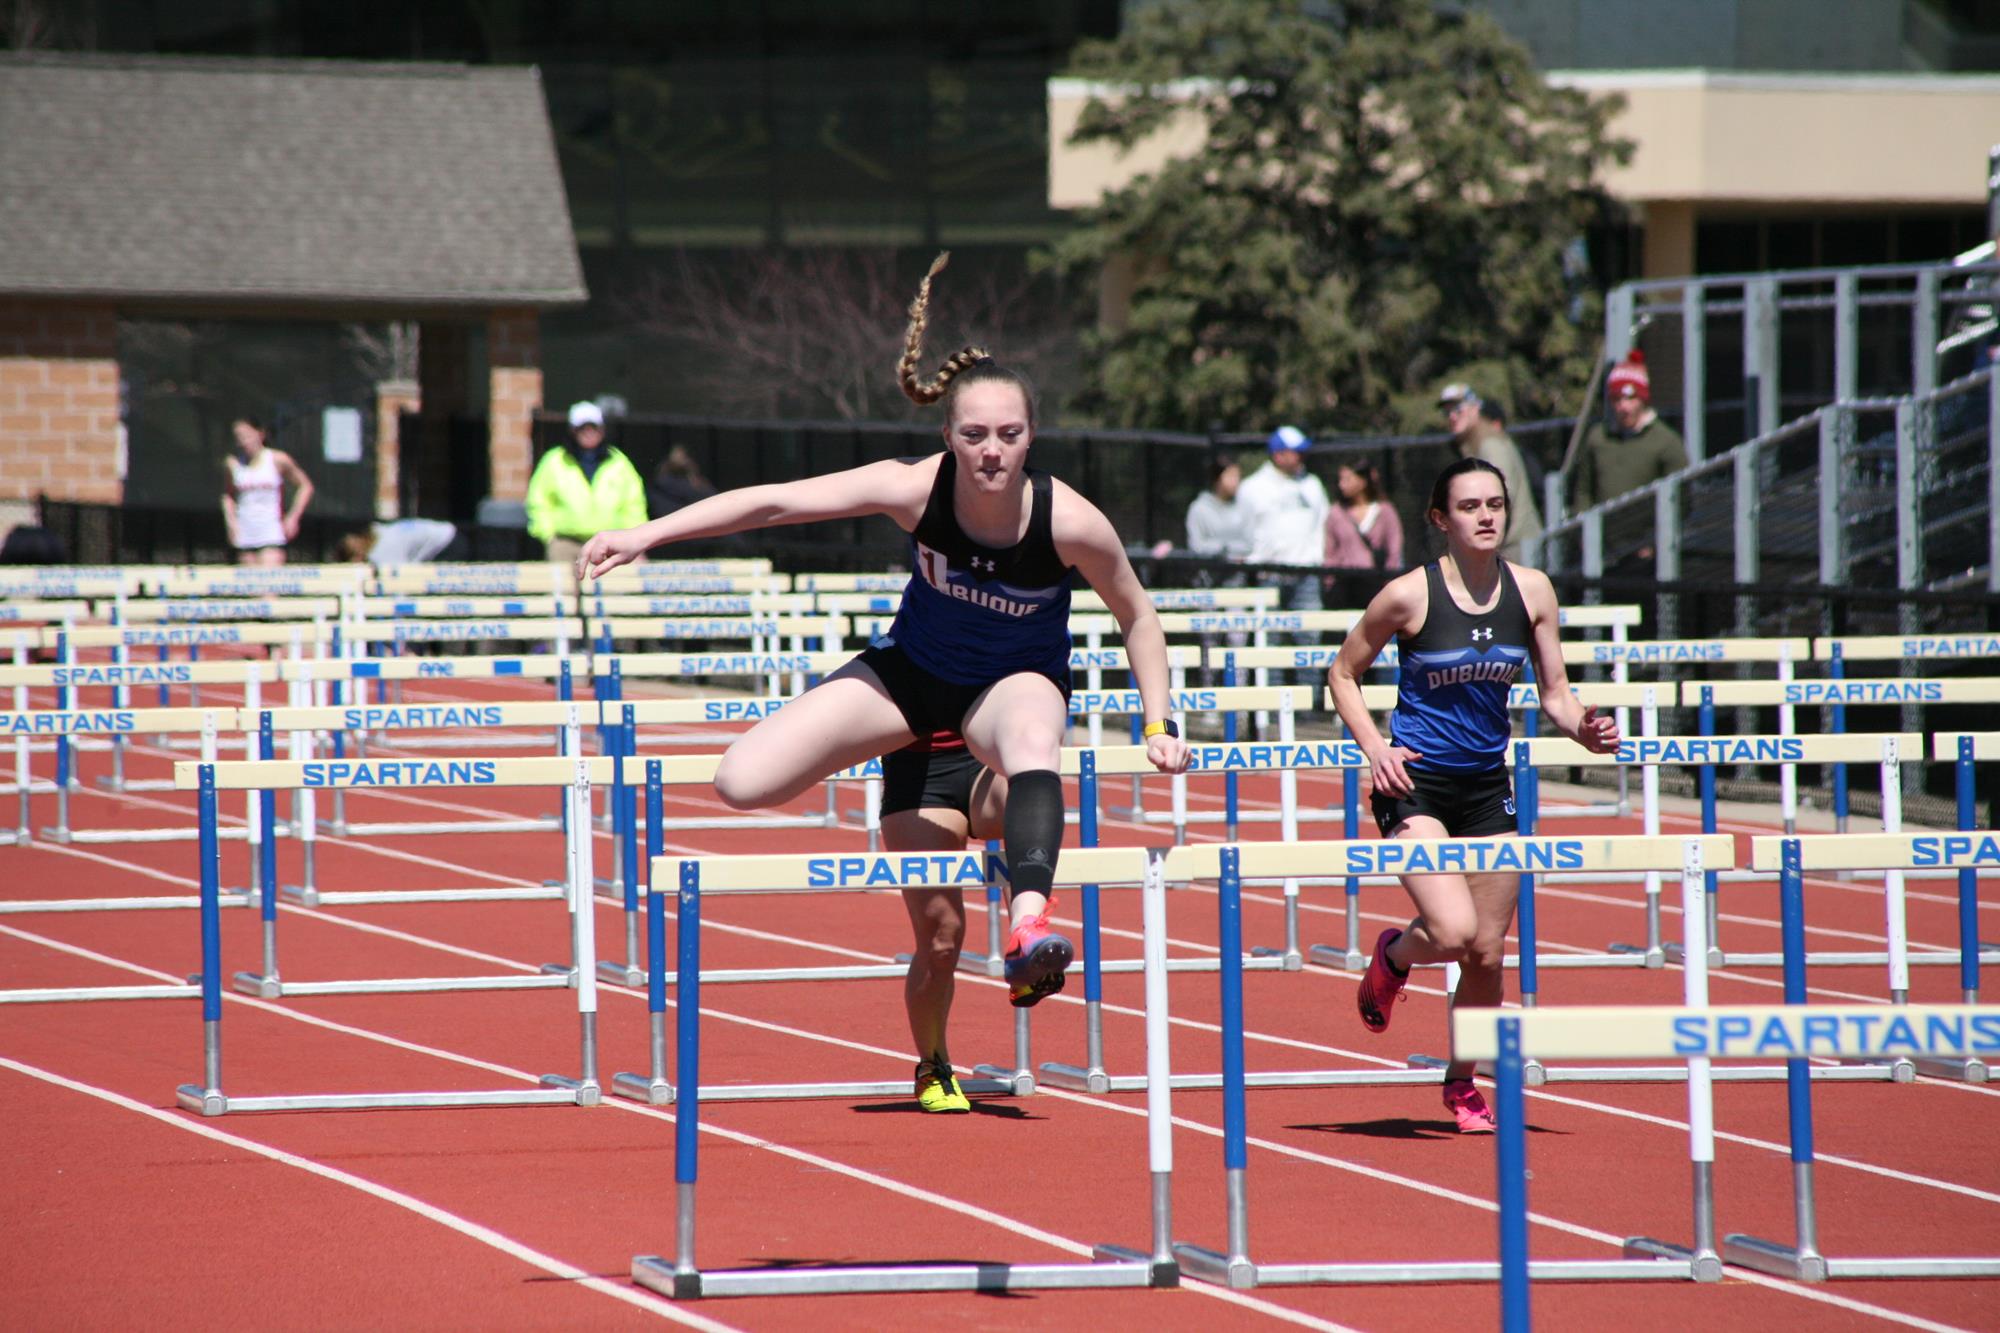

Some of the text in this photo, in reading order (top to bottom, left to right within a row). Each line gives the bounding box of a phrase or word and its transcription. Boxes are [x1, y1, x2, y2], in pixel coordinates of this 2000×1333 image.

[394, 623, 509, 640] SPARTANS
[664, 621, 777, 638] SPARTANS
[1190, 615, 1302, 631] SPARTANS
[123, 629, 240, 645] SPARTANS
[1594, 643, 1725, 661] SPARTANS
[53, 665, 190, 683] SPARTANS
[681, 655, 811, 674] SPARTANS
[1785, 682, 1943, 703] SPARTANS
[345, 707, 502, 730] SPARTANS
[1188, 743, 1363, 770] SPARTANS
[1615, 738, 1804, 763] SPARTANS
[303, 762, 495, 786] SPARTANS
[1345, 841, 1584, 874] SPARTANS
[808, 855, 1012, 887] SPARTAN
[1671, 1014, 2000, 1053] SPARTANS
